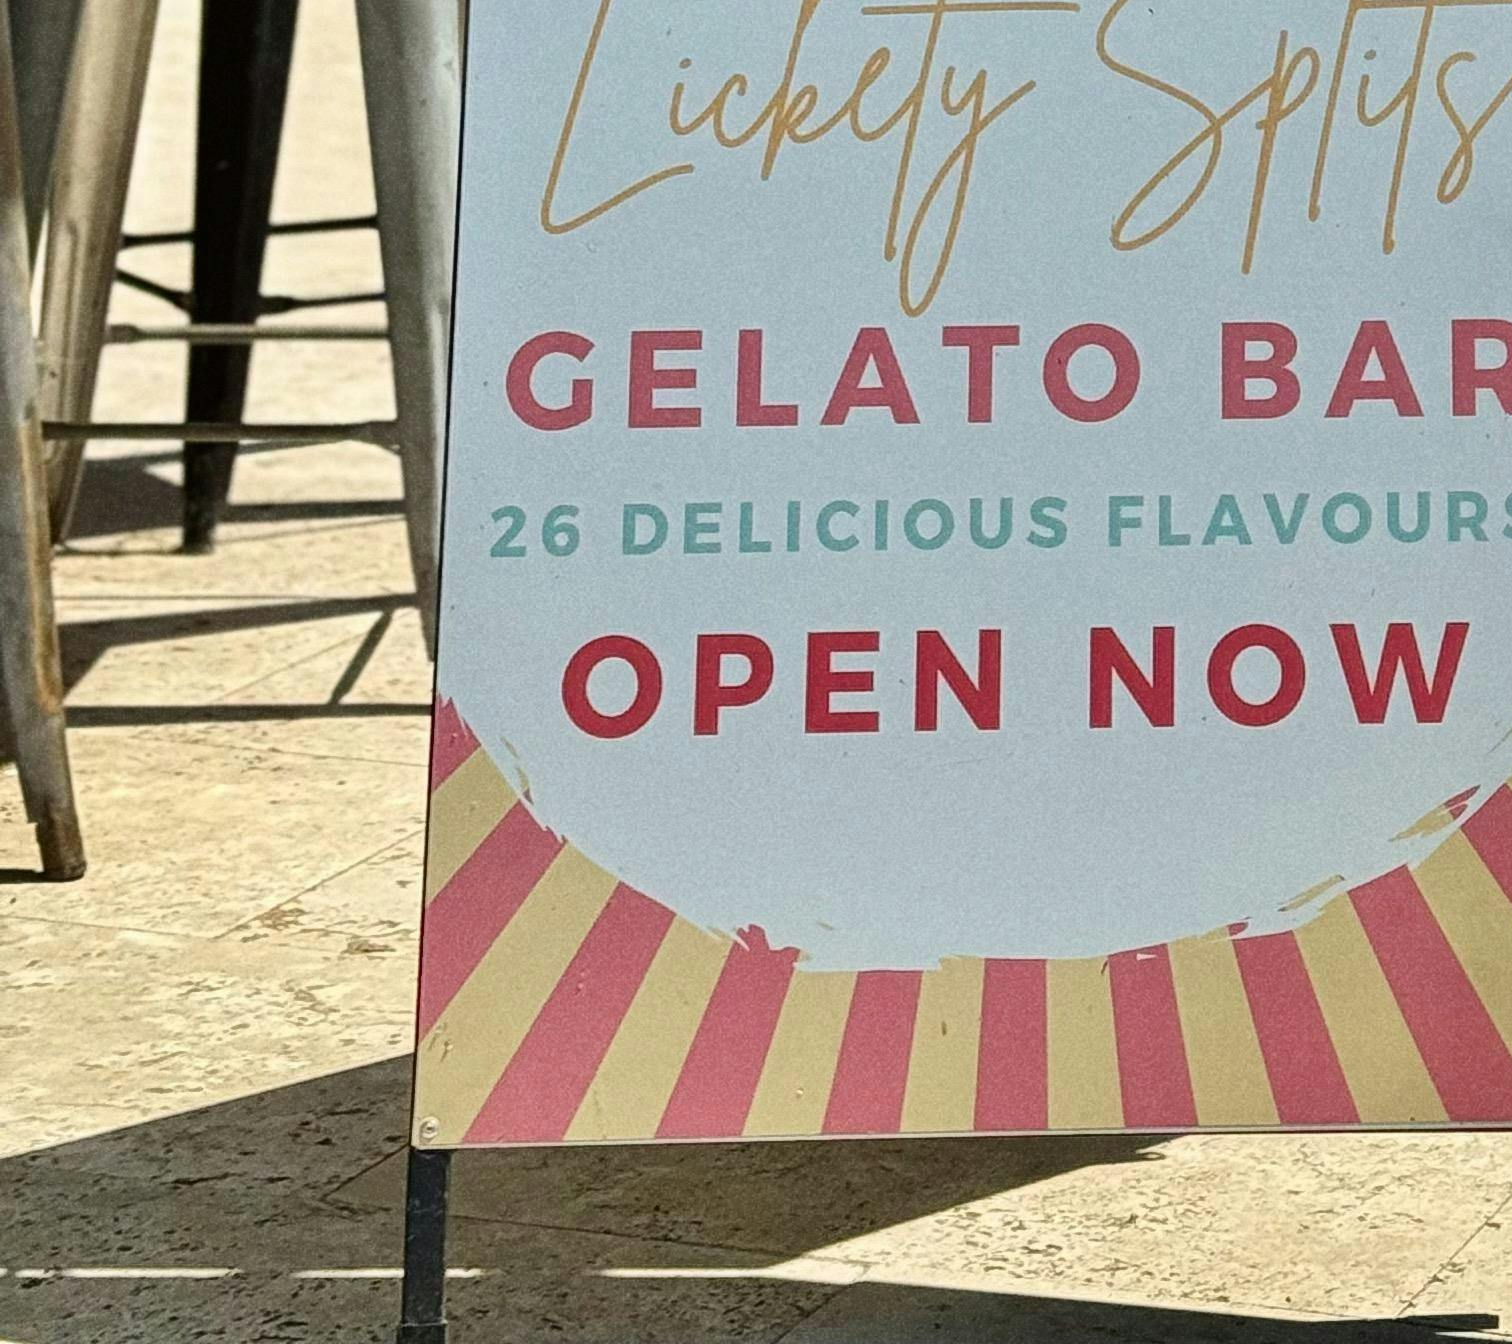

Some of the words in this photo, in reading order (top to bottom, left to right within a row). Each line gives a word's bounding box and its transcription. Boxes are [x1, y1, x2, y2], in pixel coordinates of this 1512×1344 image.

[504, 322, 1142, 432] GELATO
[488, 504, 583, 560] 26
[621, 495, 1069, 558] DELICIOUS
[560, 629, 1002, 740] OPEN
[1089, 621, 1471, 730] NOW
